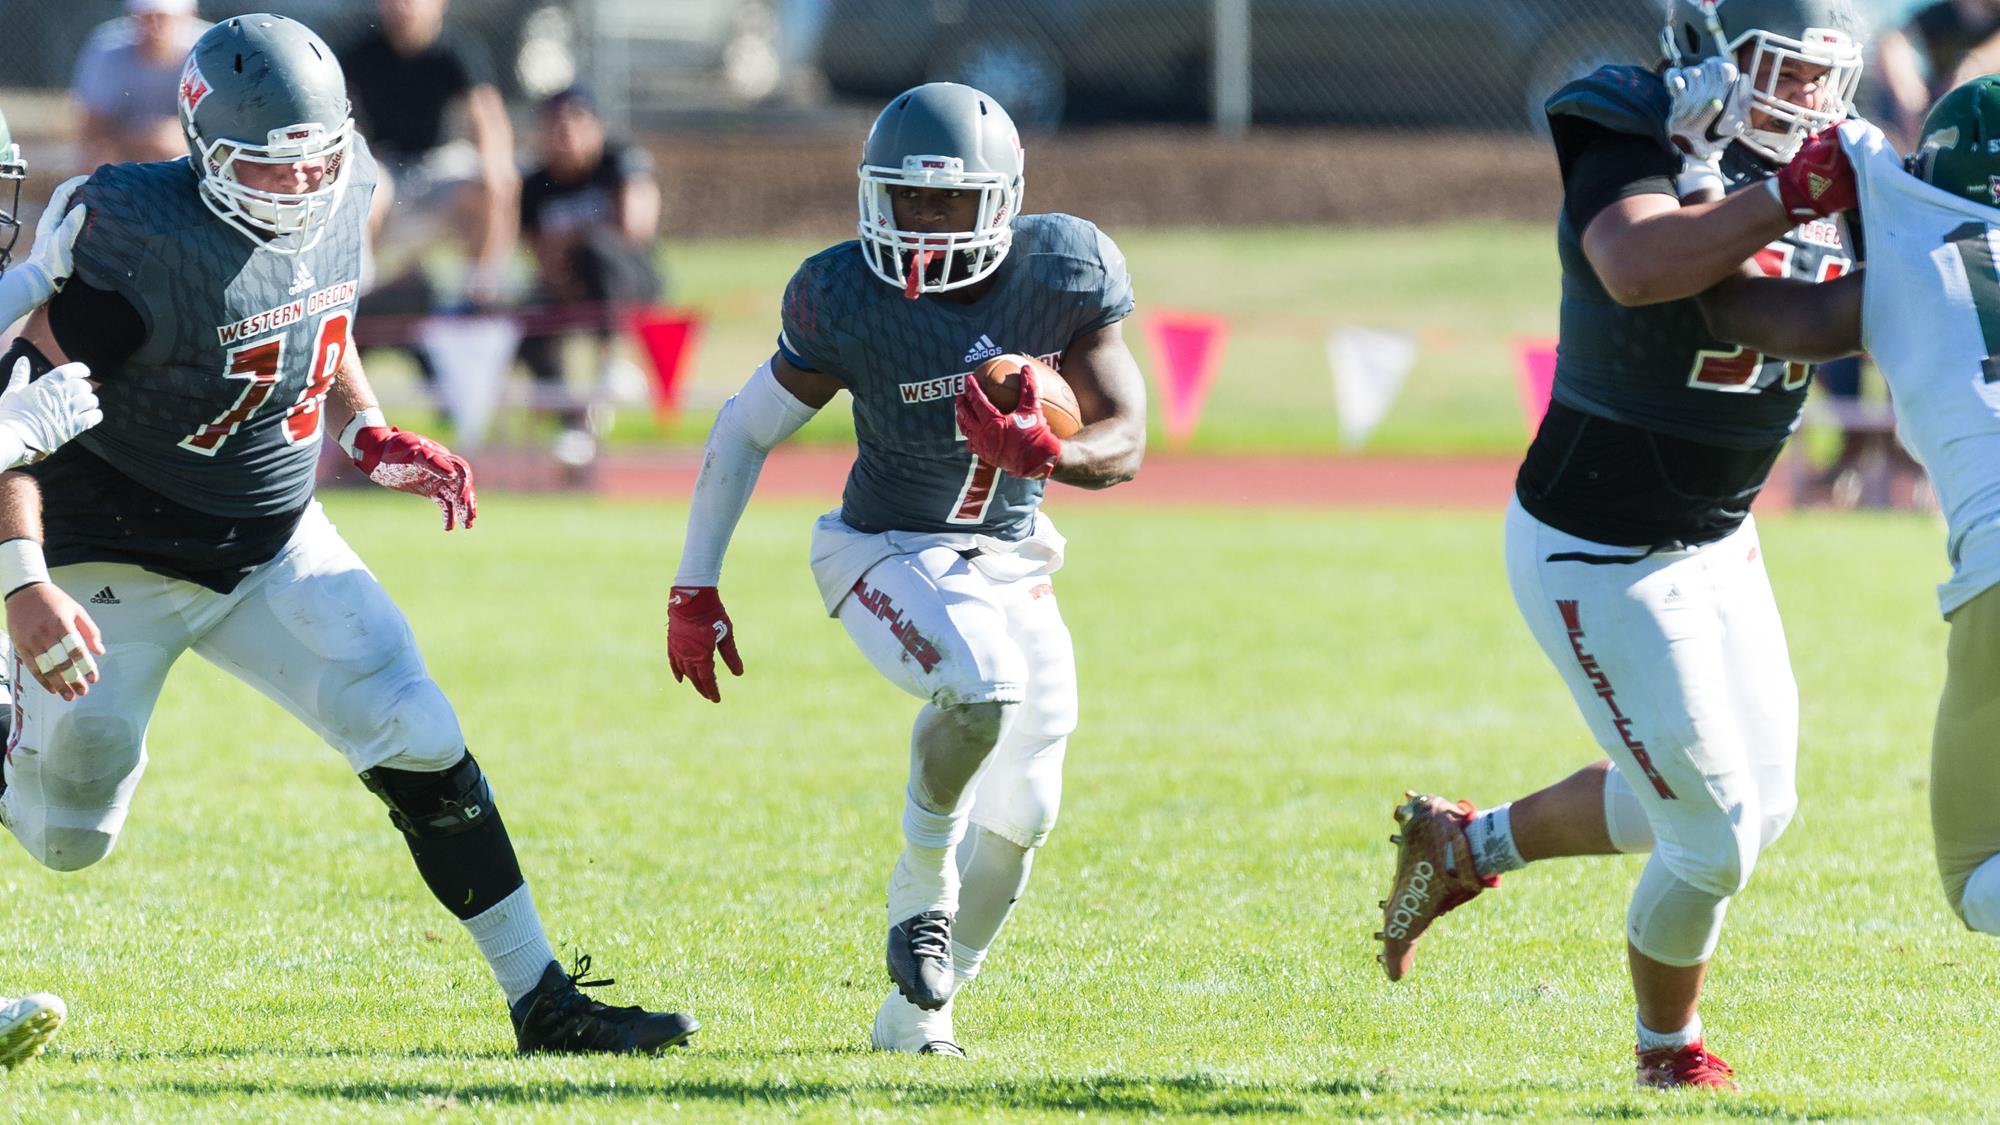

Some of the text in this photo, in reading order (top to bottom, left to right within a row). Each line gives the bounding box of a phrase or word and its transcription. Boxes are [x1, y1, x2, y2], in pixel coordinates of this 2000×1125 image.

[218, 281, 357, 345] WESTERN OREGON
[177, 308, 353, 456] 78
[965, 346, 1002, 363] adidas
[900, 374, 967, 403] WESTE
[1388, 861, 1434, 940] adidas
